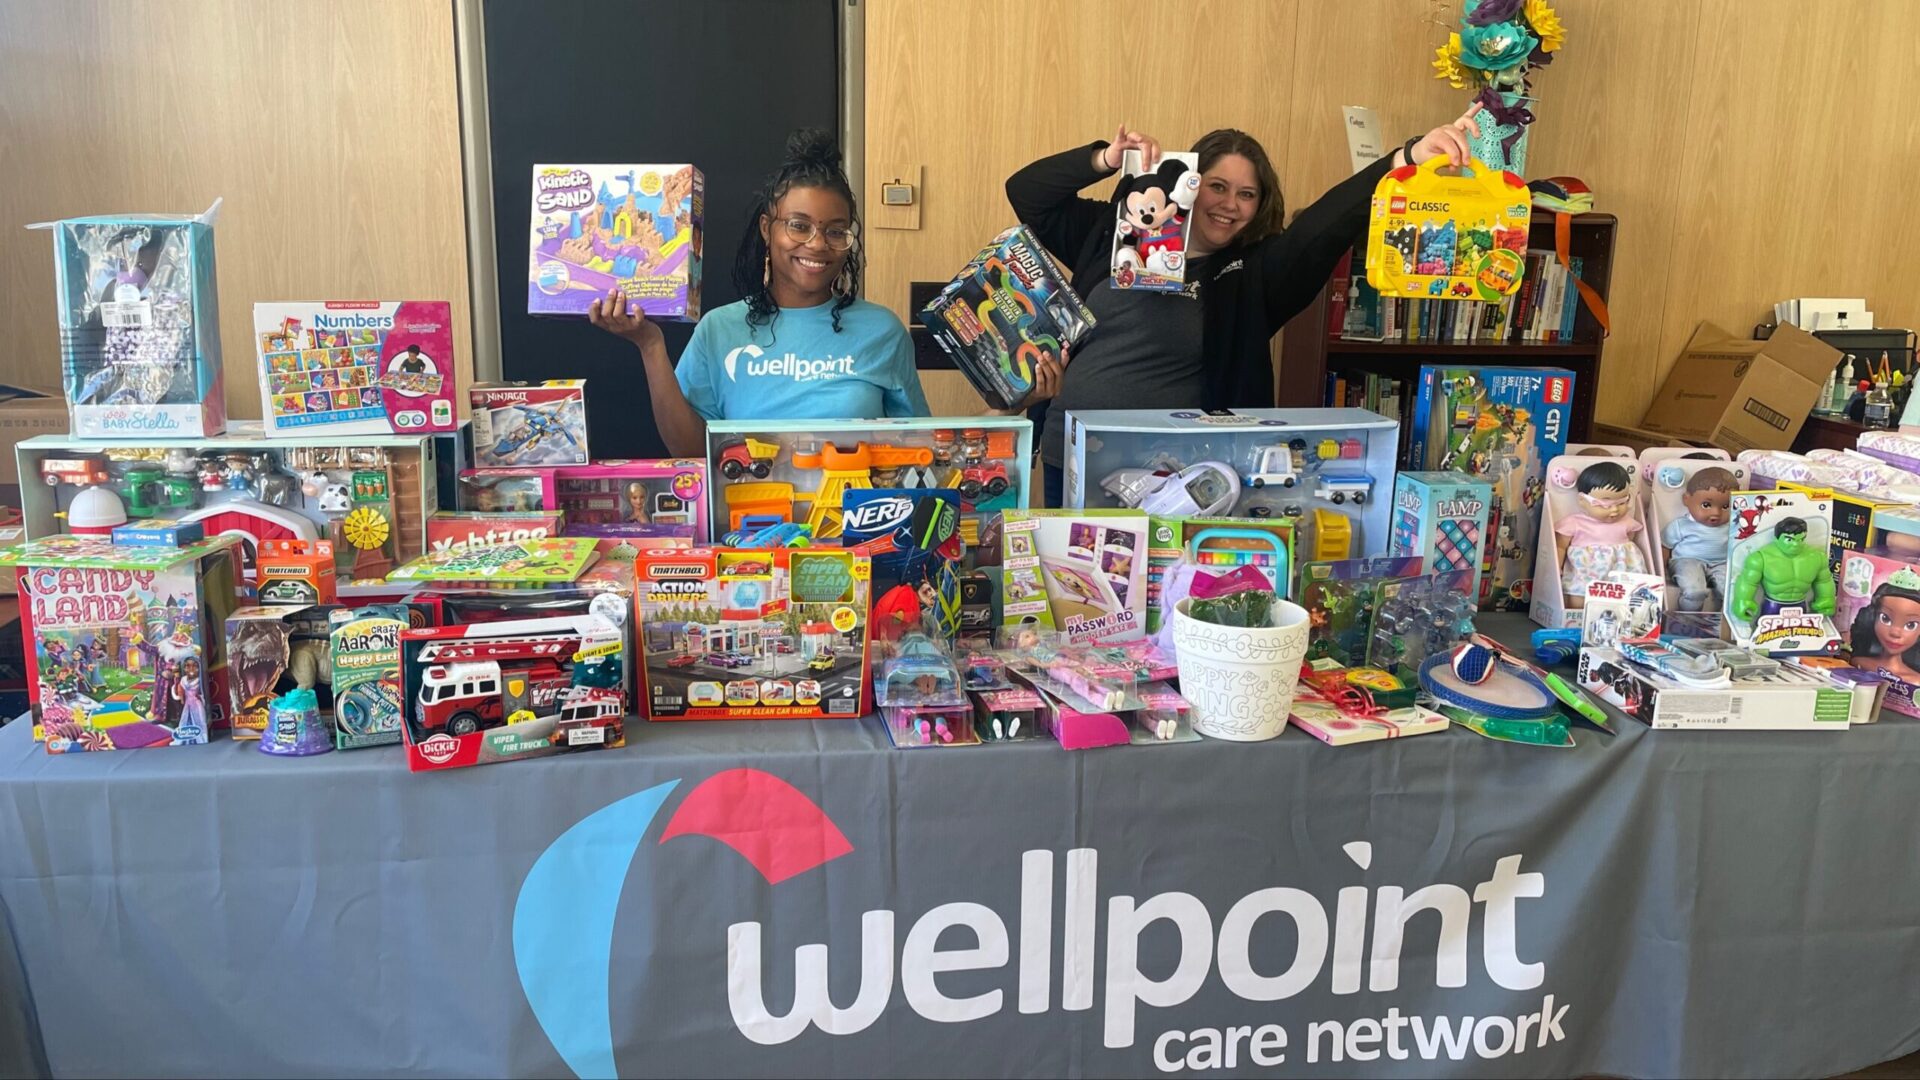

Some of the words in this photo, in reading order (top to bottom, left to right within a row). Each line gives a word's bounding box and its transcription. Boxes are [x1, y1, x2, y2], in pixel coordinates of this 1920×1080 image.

[539, 171, 590, 190] Kinetic
[1391, 200, 1406, 210] LEGO
[1009, 242, 1044, 281] MAGIC
[314, 313, 392, 328] Numbers
[747, 353, 855, 382] wellpoint
[1532, 376, 1542, 391] 7+
[1552, 378, 1564, 403] LEGO
[486, 392, 529, 403] NINJAGO
[1544, 408, 1560, 444] CITY
[675, 472, 702, 489] 25+
[1398, 492, 1422, 511] LAMP
[1438, 500, 1482, 518] LAMP
[842, 500, 911, 530] NERF
[1842, 540, 1856, 549] KIT
[800, 563, 843, 574] SUPER
[34, 566, 155, 595] CANDY
[651, 582, 707, 592] ACTION
[796, 575, 850, 586] CLEAN
[1588, 582, 1626, 592] STAR
[646, 593, 708, 602] DRIVERS
[1588, 589, 1626, 600] WARS
[36, 595, 128, 625] LAND
[1761, 618, 1820, 633] SPIDEY
[1756, 628, 1792, 644] AMAZING
[1792, 628, 1824, 637] FRIENDS
[582, 650, 598, 658] LIGHT
[602, 645, 620, 653] SOUND
[340, 654, 372, 665] Happy
[1889, 682, 1909, 695] CESS
[752, 708, 774, 716] CLEAN
[494, 734, 515, 744] VIPER
[502, 743, 518, 752] FIRE
[520, 740, 542, 750] TRUCK
[728, 842, 1545, 1048] wellpoint
[1154, 1025, 1288, 1071] care
[1307, 993, 1570, 1063] network
